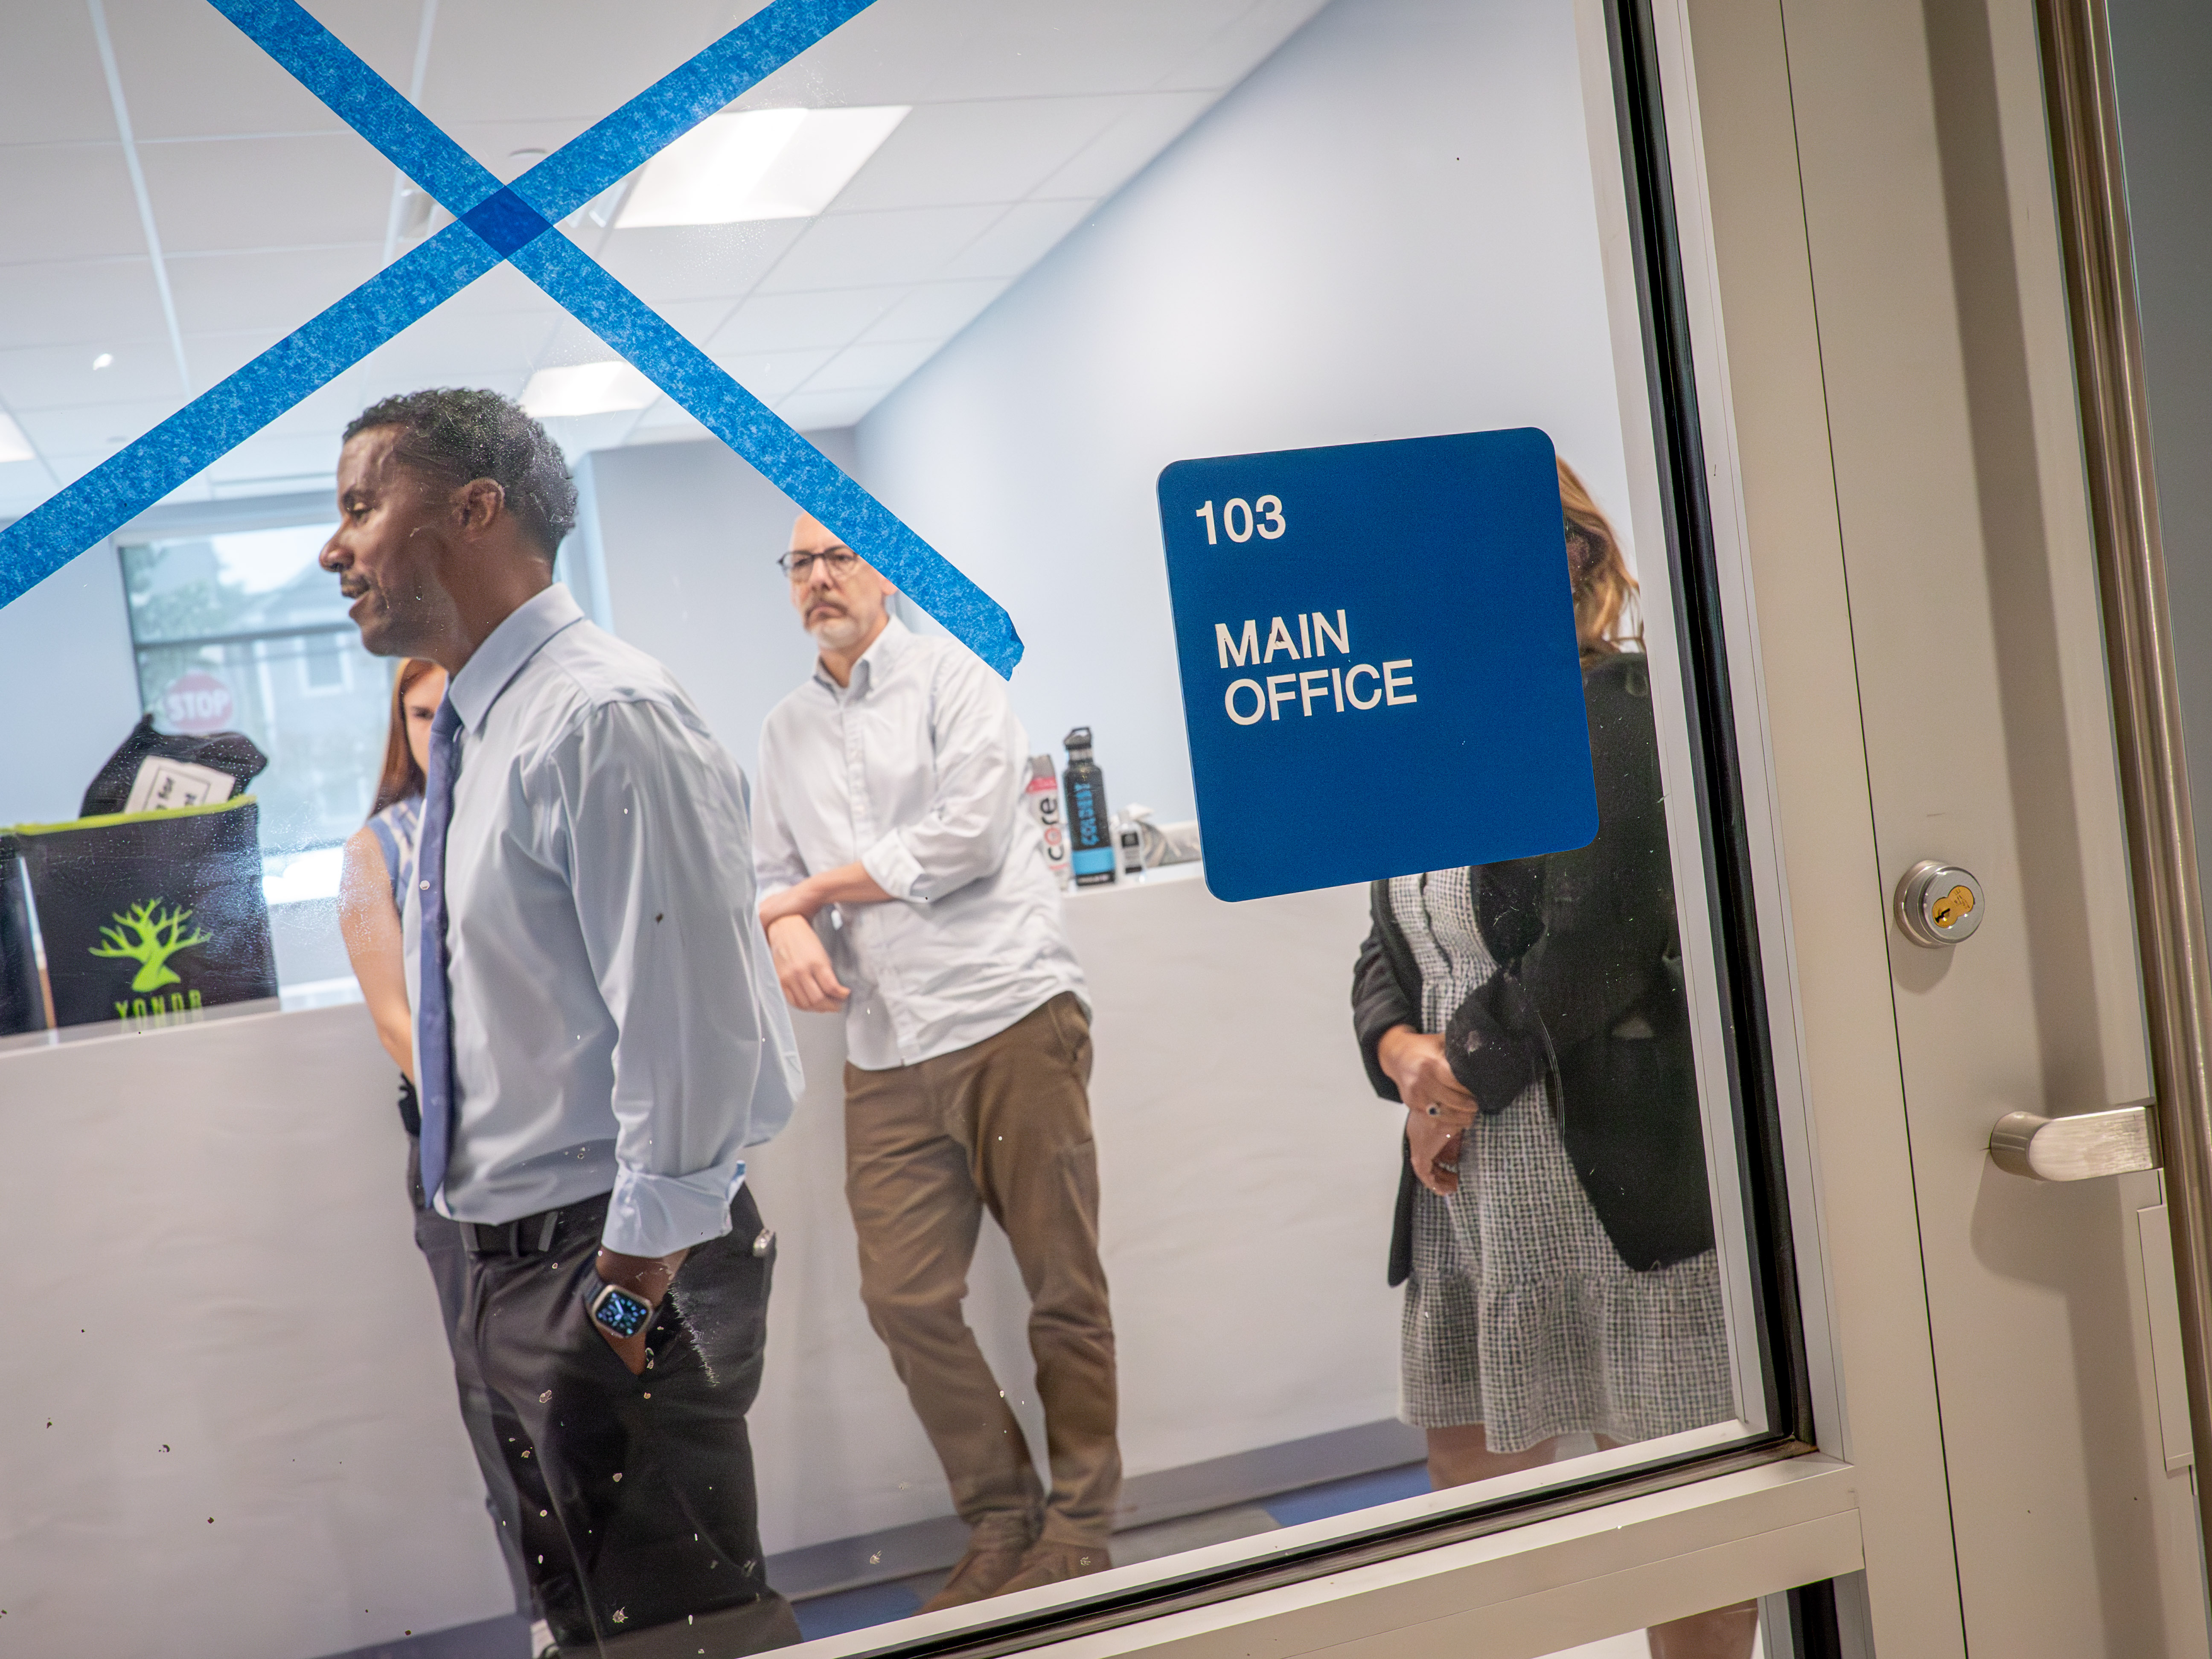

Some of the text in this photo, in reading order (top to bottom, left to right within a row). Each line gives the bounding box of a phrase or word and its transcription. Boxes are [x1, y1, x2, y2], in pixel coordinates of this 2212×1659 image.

[1196, 495, 1286, 545] 103
[1215, 609, 1350, 669] MAIN
[167, 689, 230, 722] STOP
[1225, 659, 1417, 725] OFFICE
[1040, 797, 1065, 861] core
